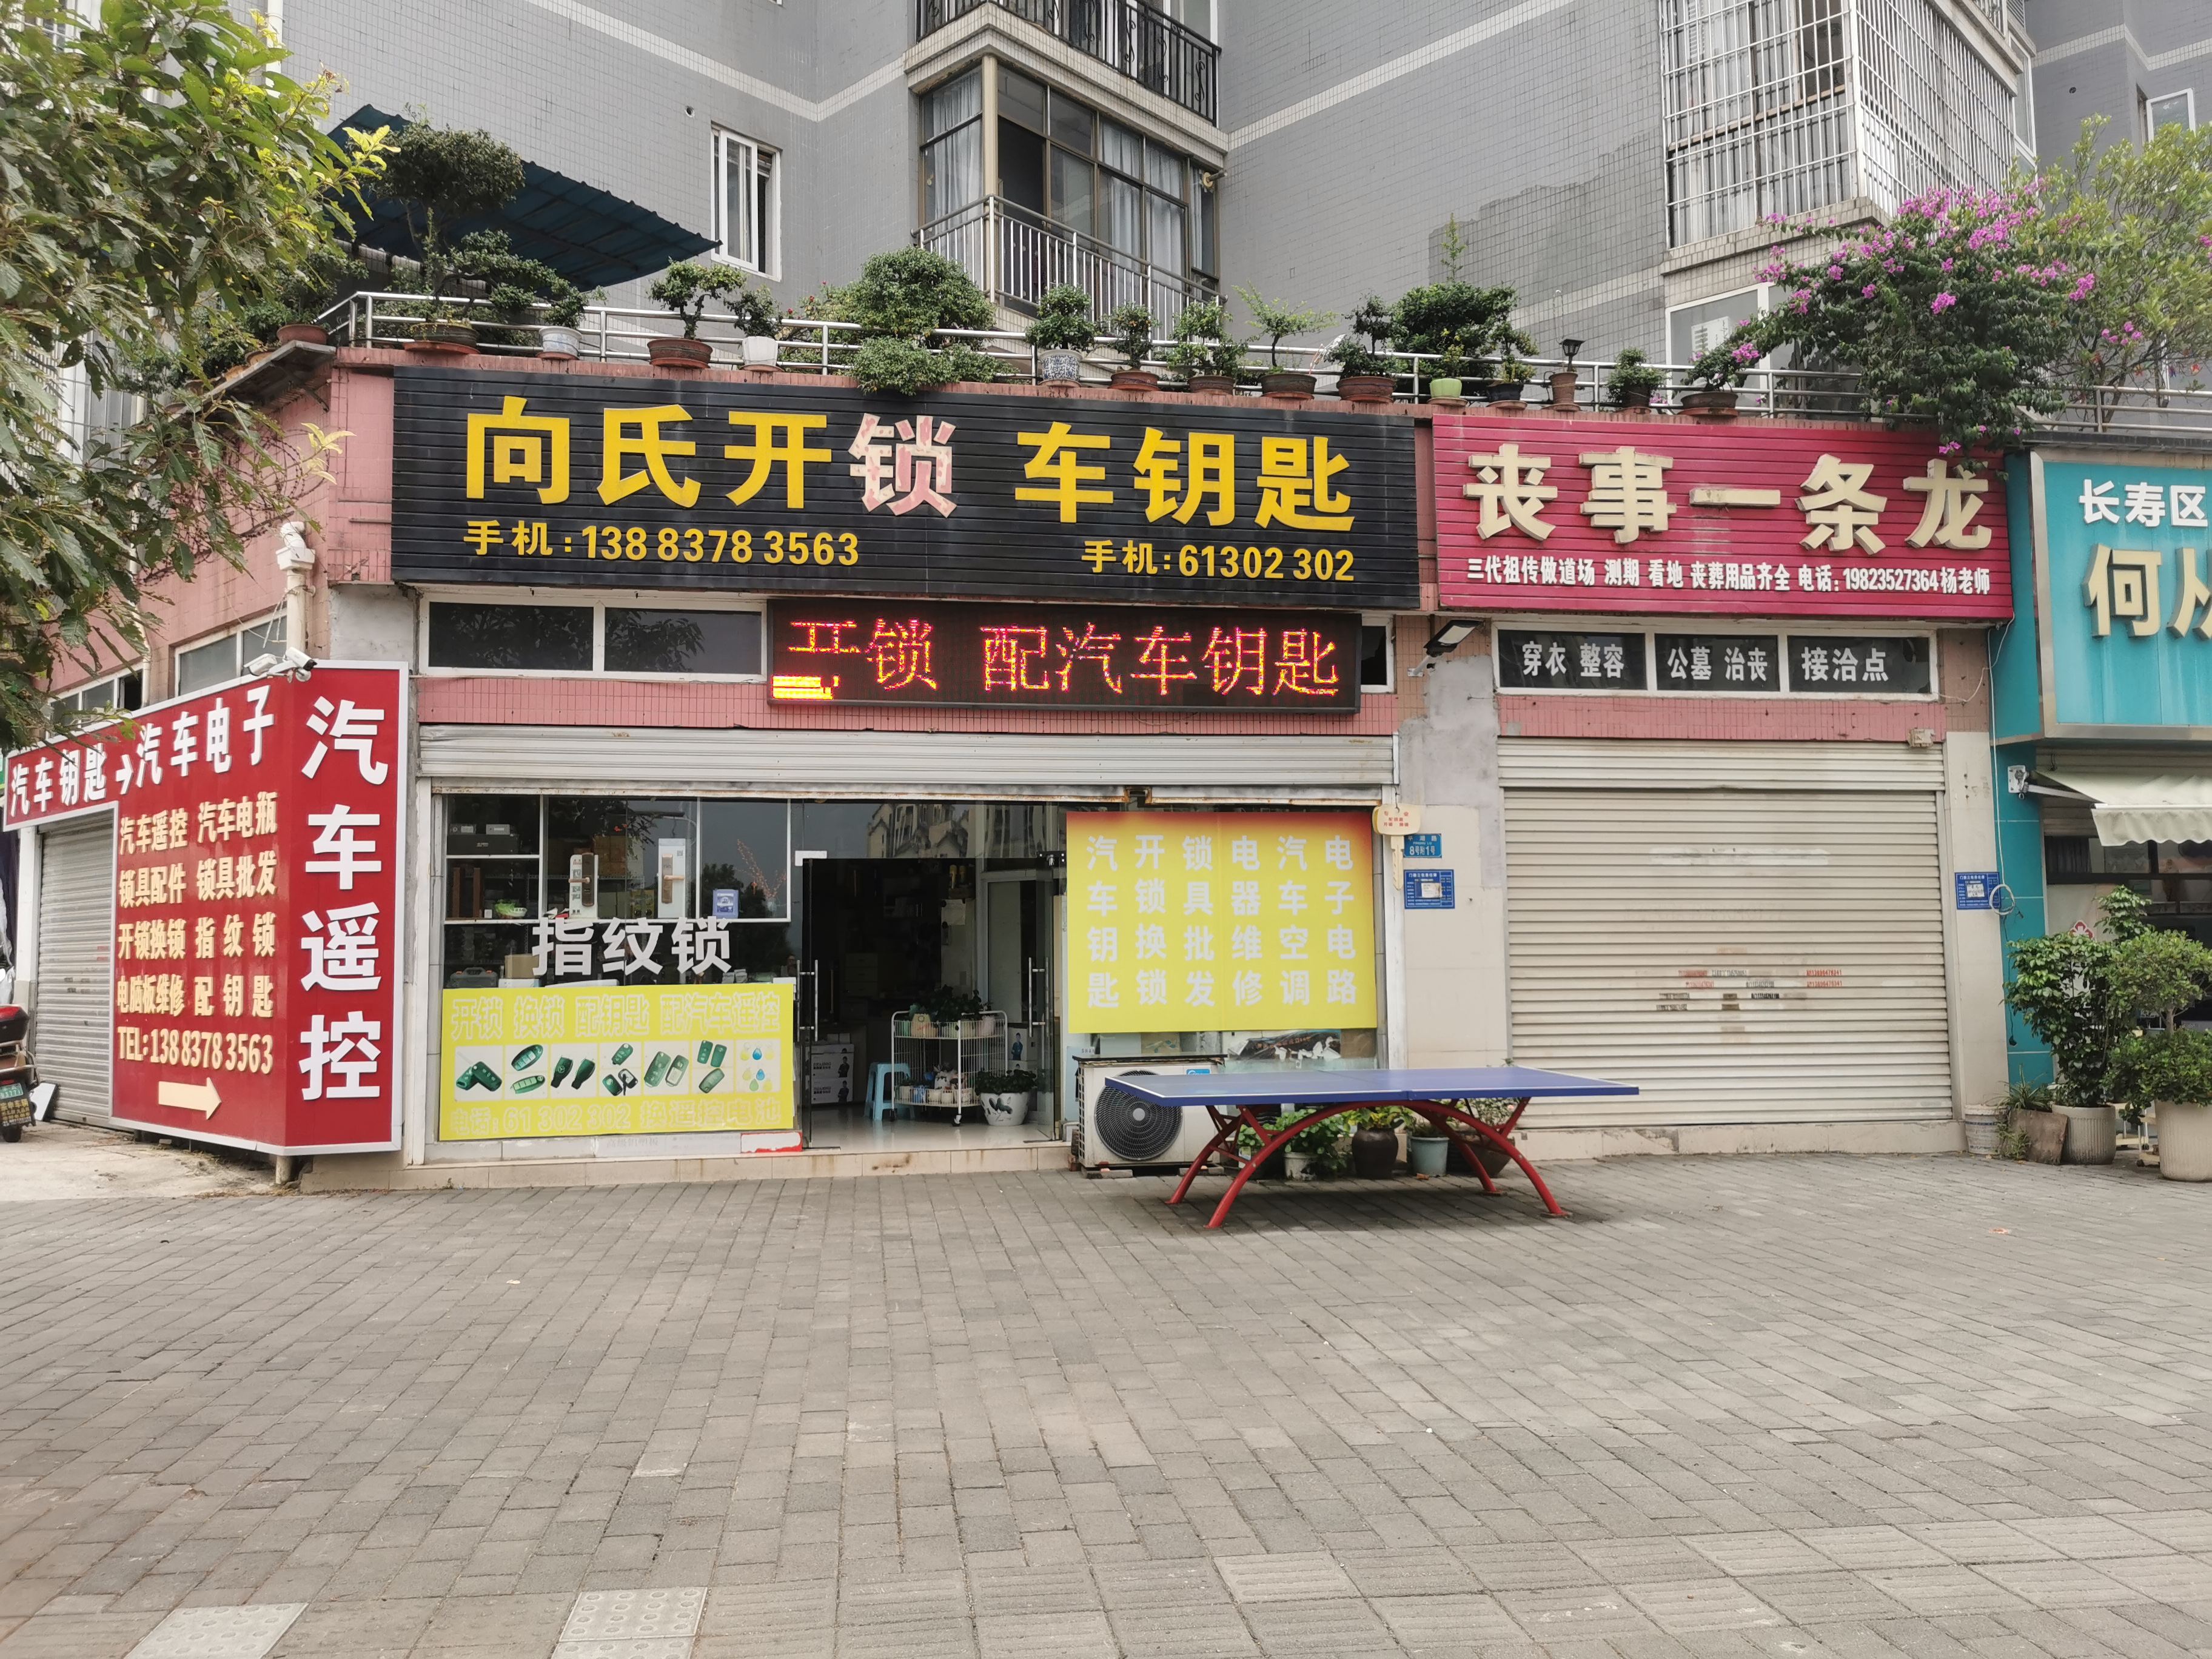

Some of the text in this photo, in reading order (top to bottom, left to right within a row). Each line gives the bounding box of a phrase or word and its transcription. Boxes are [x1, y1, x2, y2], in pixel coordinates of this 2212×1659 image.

[466, 395, 1355, 532] 向氏开锁 车钥匙
[1462, 443, 1992, 556] 丧事一条龙
[2079, 478, 2208, 528] 长寿区
[1466, 555, 1595, 586] 三代祖传做道场
[1603, 558, 1640, 586] 测期
[1647, 558, 1684, 589] 看地
[1689, 560, 1791, 592] 丧葬用品齐全
[980, 622, 1339, 696] 配汽车钥匙
[1521, 640, 1624, 679] 穿衣 整容
[1666, 646, 1769, 682] 公墓 治丧
[1801, 646, 1889, 682] 接洽点
[11, 684, 275, 818] 汽车钥匙 汽车电子
[119, 791, 278, 856] 汽车遥控 汽车电瓶
[119, 850, 277, 907] 锁具配件 锁具批发
[298, 695, 389, 1102] 汽车遥控
[118, 911, 276, 960] 开锁换锁 指纹锁
[532, 916, 732, 976] 指纹锁
[117, 973, 273, 1018] 电脑板维修 配钥匙
[451, 991, 781, 1041] 开锁 换锁 配钥匙 配汽车遥控
